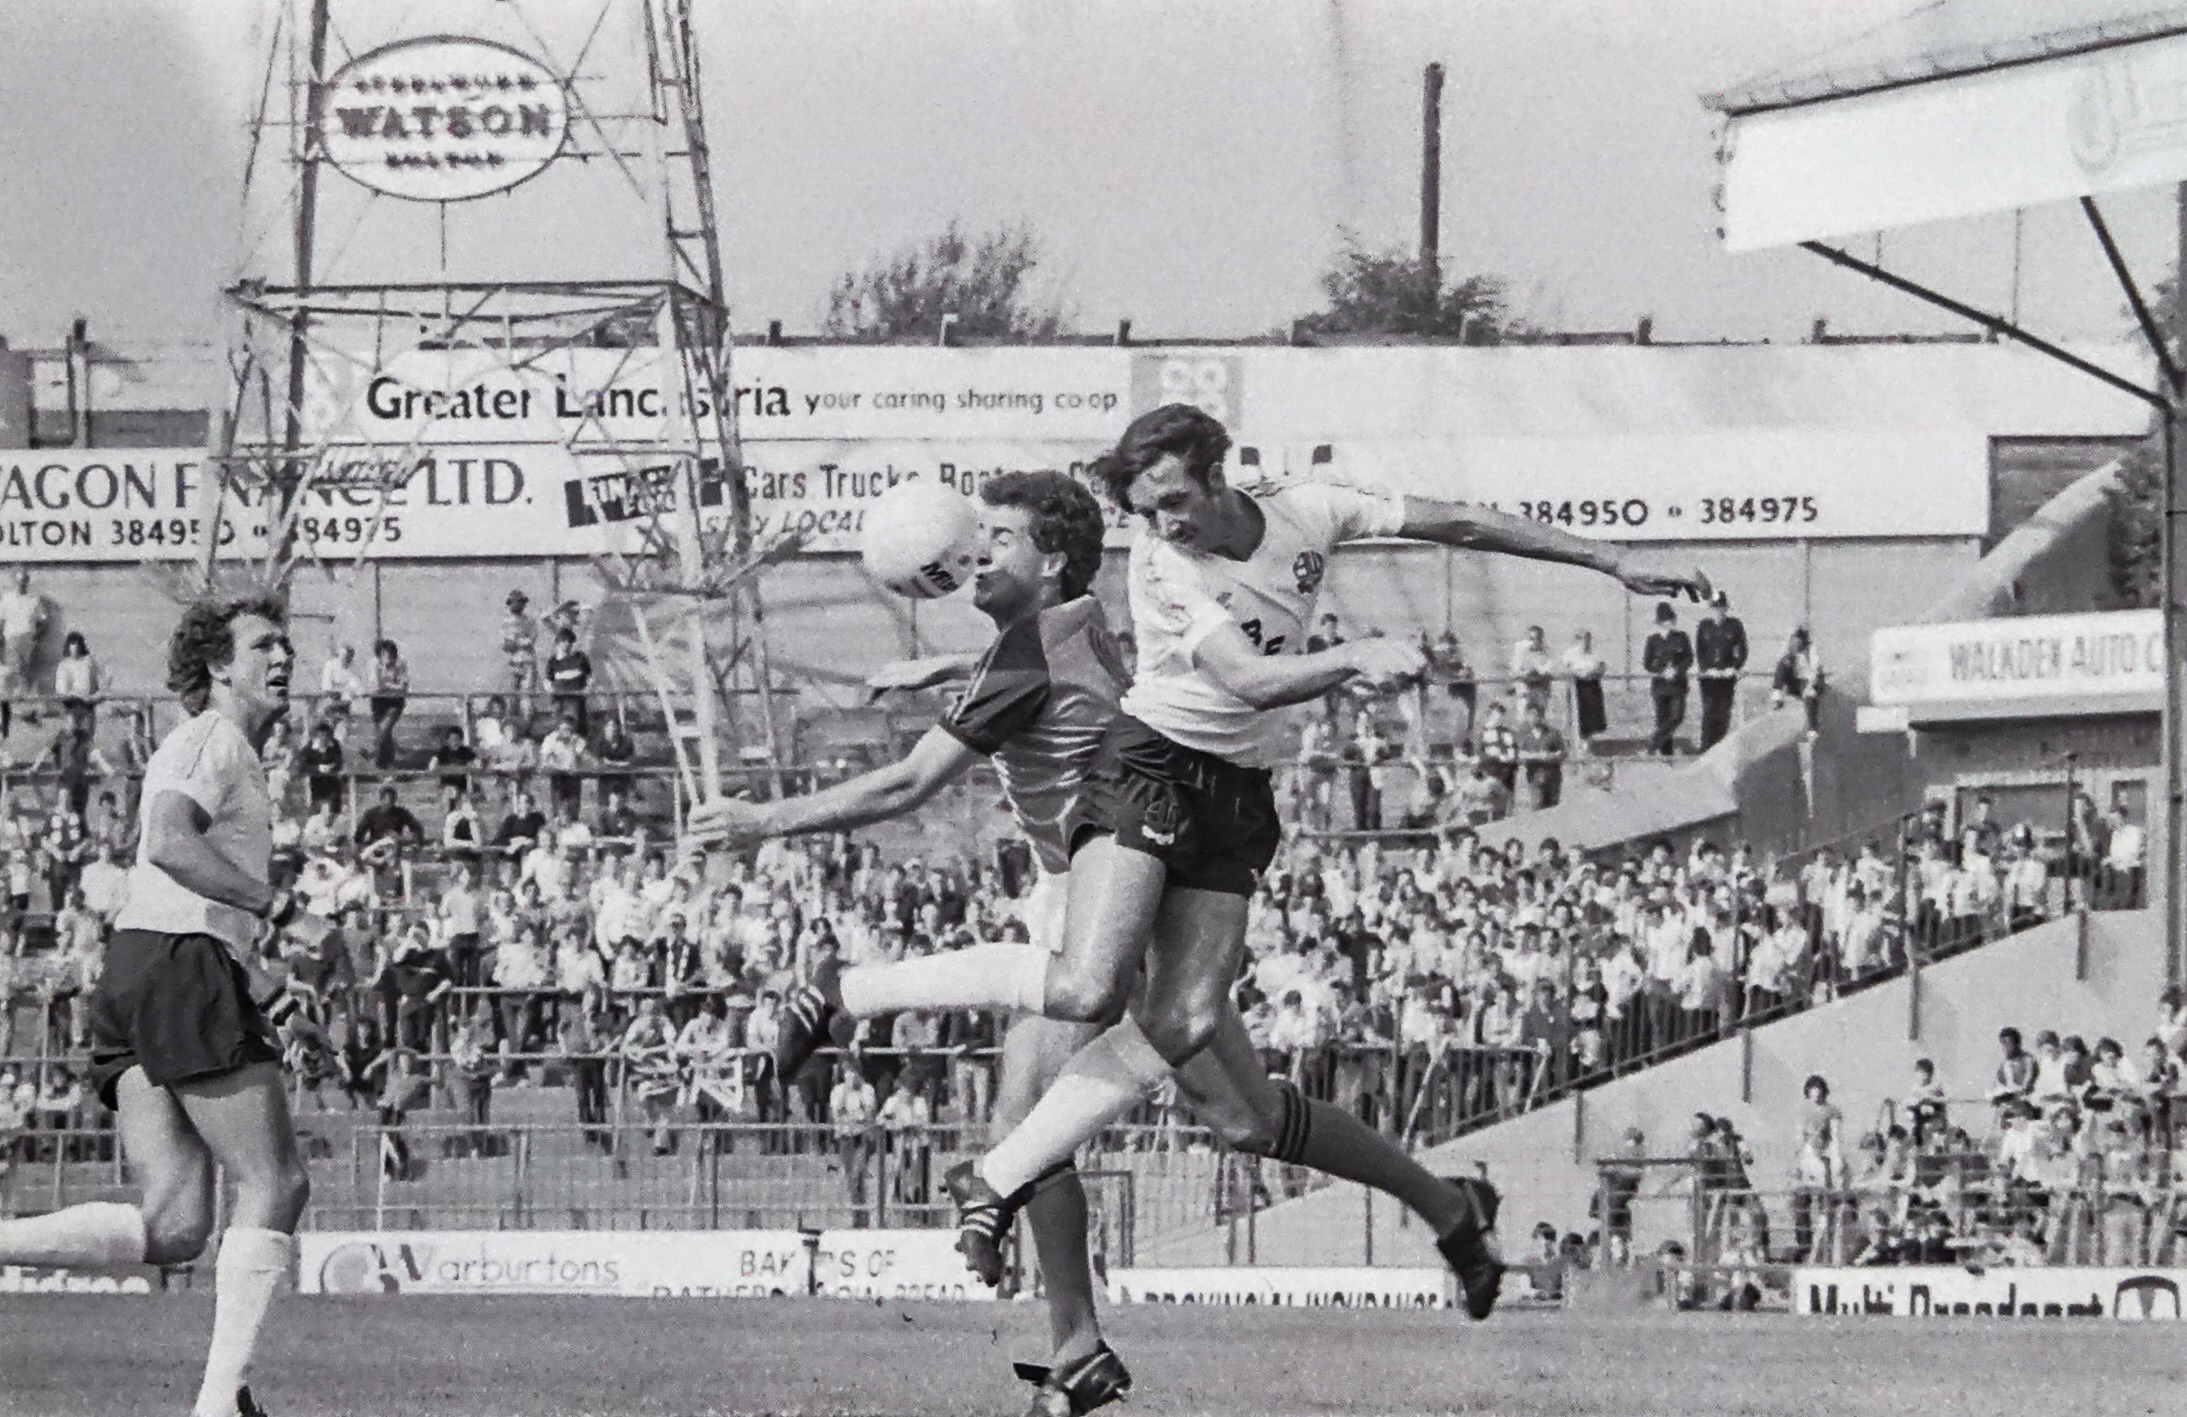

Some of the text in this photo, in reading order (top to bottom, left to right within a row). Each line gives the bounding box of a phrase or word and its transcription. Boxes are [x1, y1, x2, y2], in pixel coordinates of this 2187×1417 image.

[335, 103, 550, 139] WATSON
[367, 376, 531, 419] Greater
[556, 373, 791, 418] Lancsria
[804, 393, 862, 416] your
[873, 392, 946, 413] caring
[957, 389, 1043, 415] sharing
[0, 464, 156, 509] AGON
[428, 458, 533, 505] LTD.
[742, 466, 807, 499] Cars
[1701, 496, 1819, 525] 384975
[0, 520, 91, 547] LTON
[2071, 631, 2137, 676] AUTO
